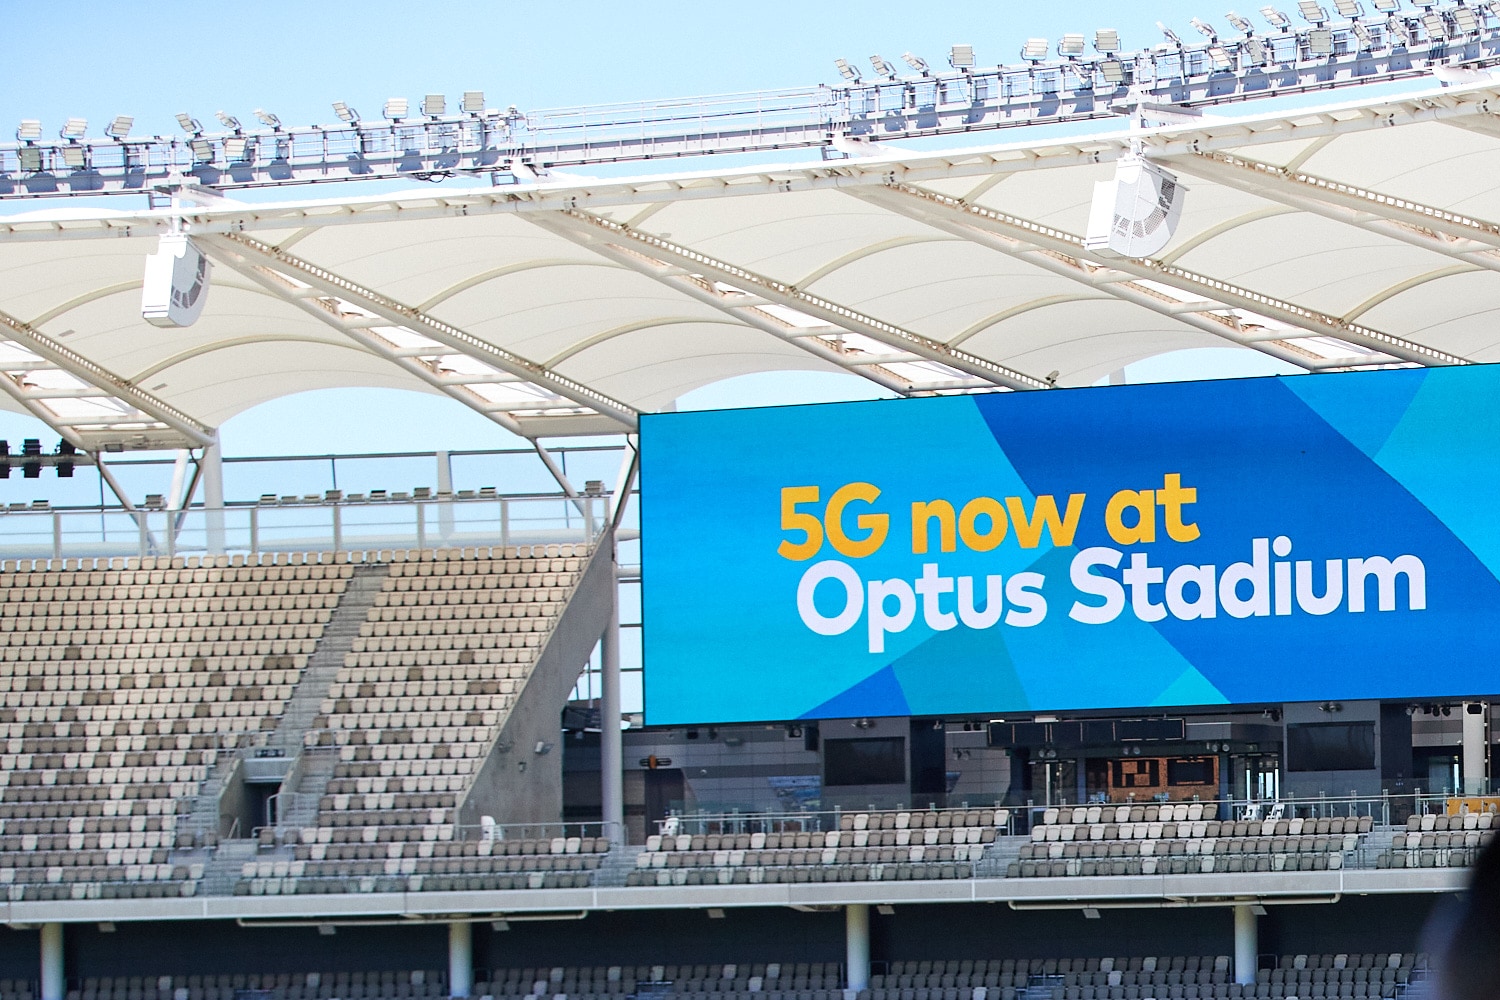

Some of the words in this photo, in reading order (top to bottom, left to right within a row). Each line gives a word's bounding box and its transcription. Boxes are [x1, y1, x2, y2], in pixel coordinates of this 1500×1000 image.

[777, 482, 890, 561] 5G
[911, 493, 1087, 554] now
[1105, 473, 1201, 545] at
[797, 560, 1048, 654] Optus
[1068, 535, 1427, 625] Stadium
